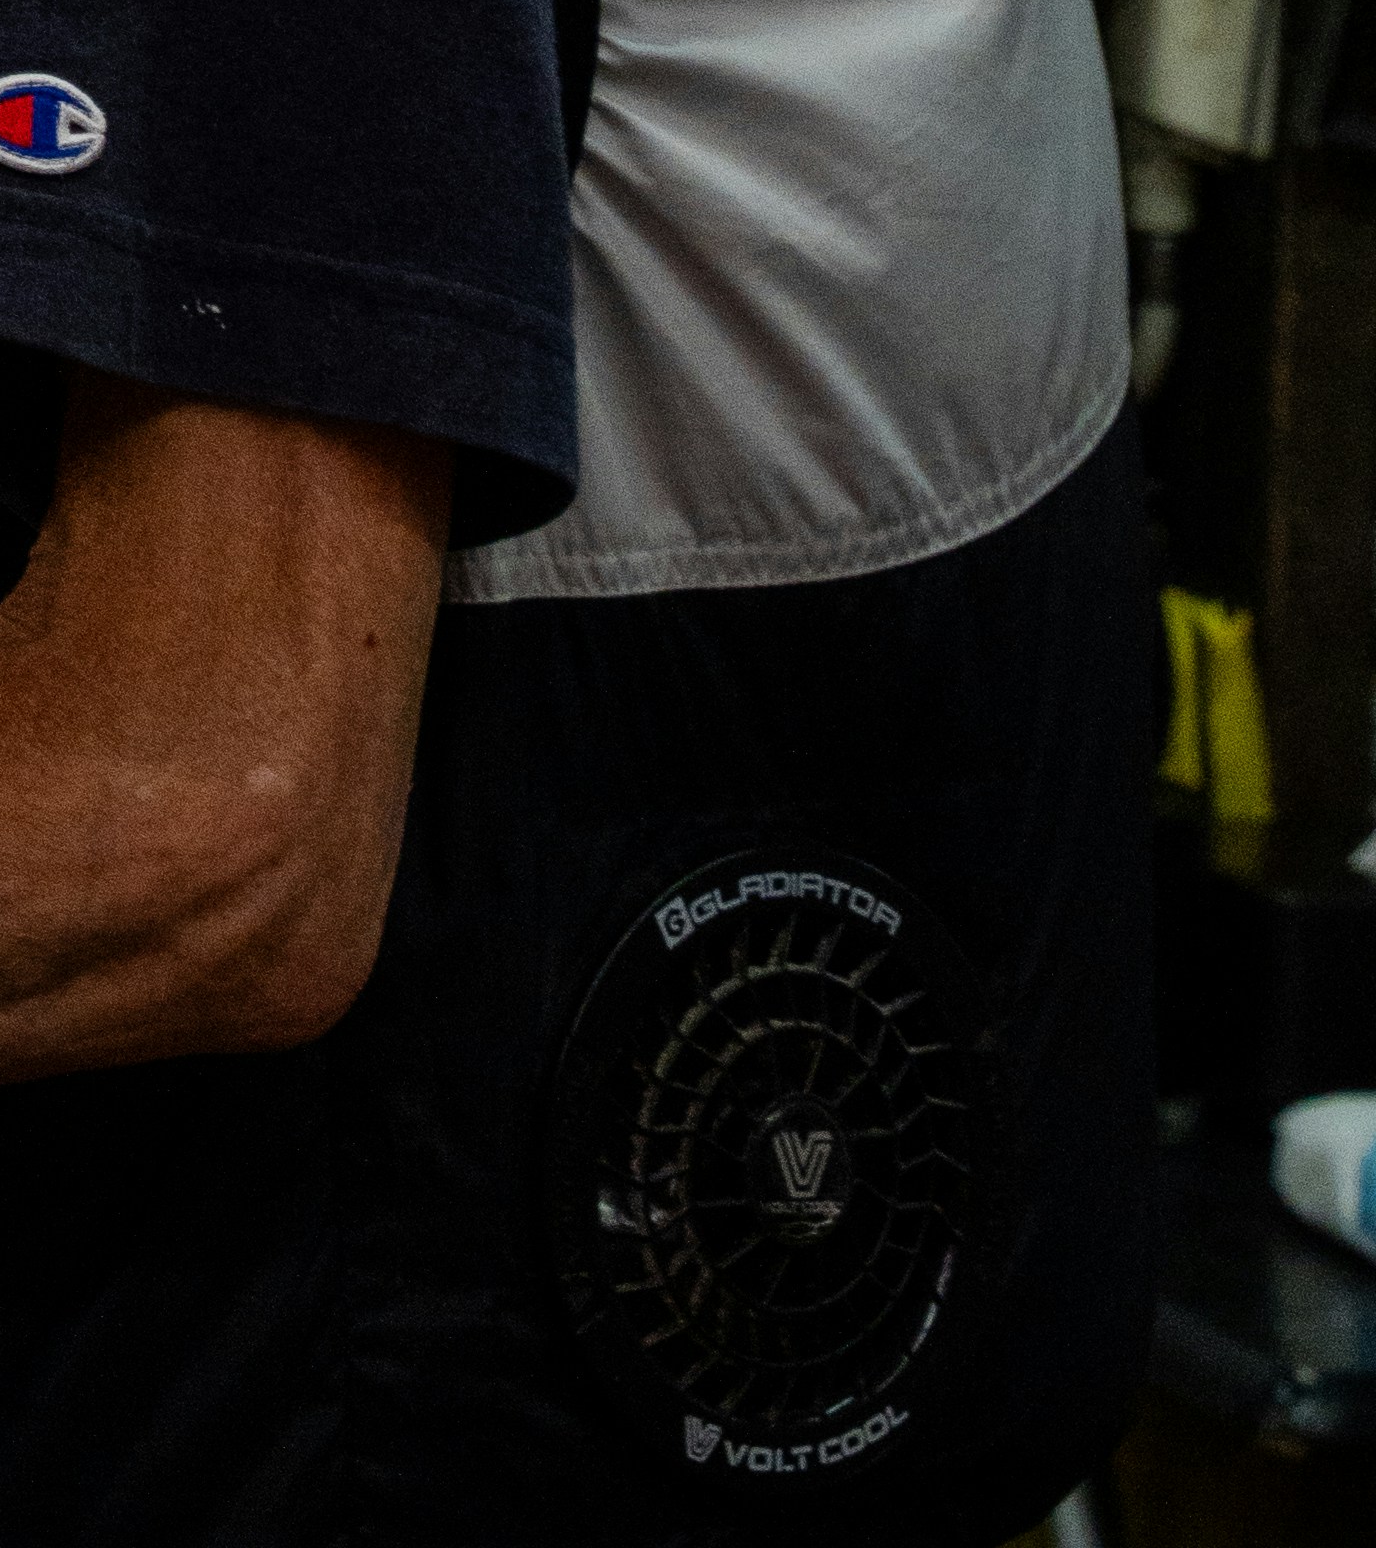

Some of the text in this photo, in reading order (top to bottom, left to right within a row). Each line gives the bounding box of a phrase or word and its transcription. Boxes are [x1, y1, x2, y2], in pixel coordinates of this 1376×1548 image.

[689, 871, 903, 938] GLADIATOR
[722, 1438, 814, 1473] VOLT
[817, 1404, 911, 1466] COOL
